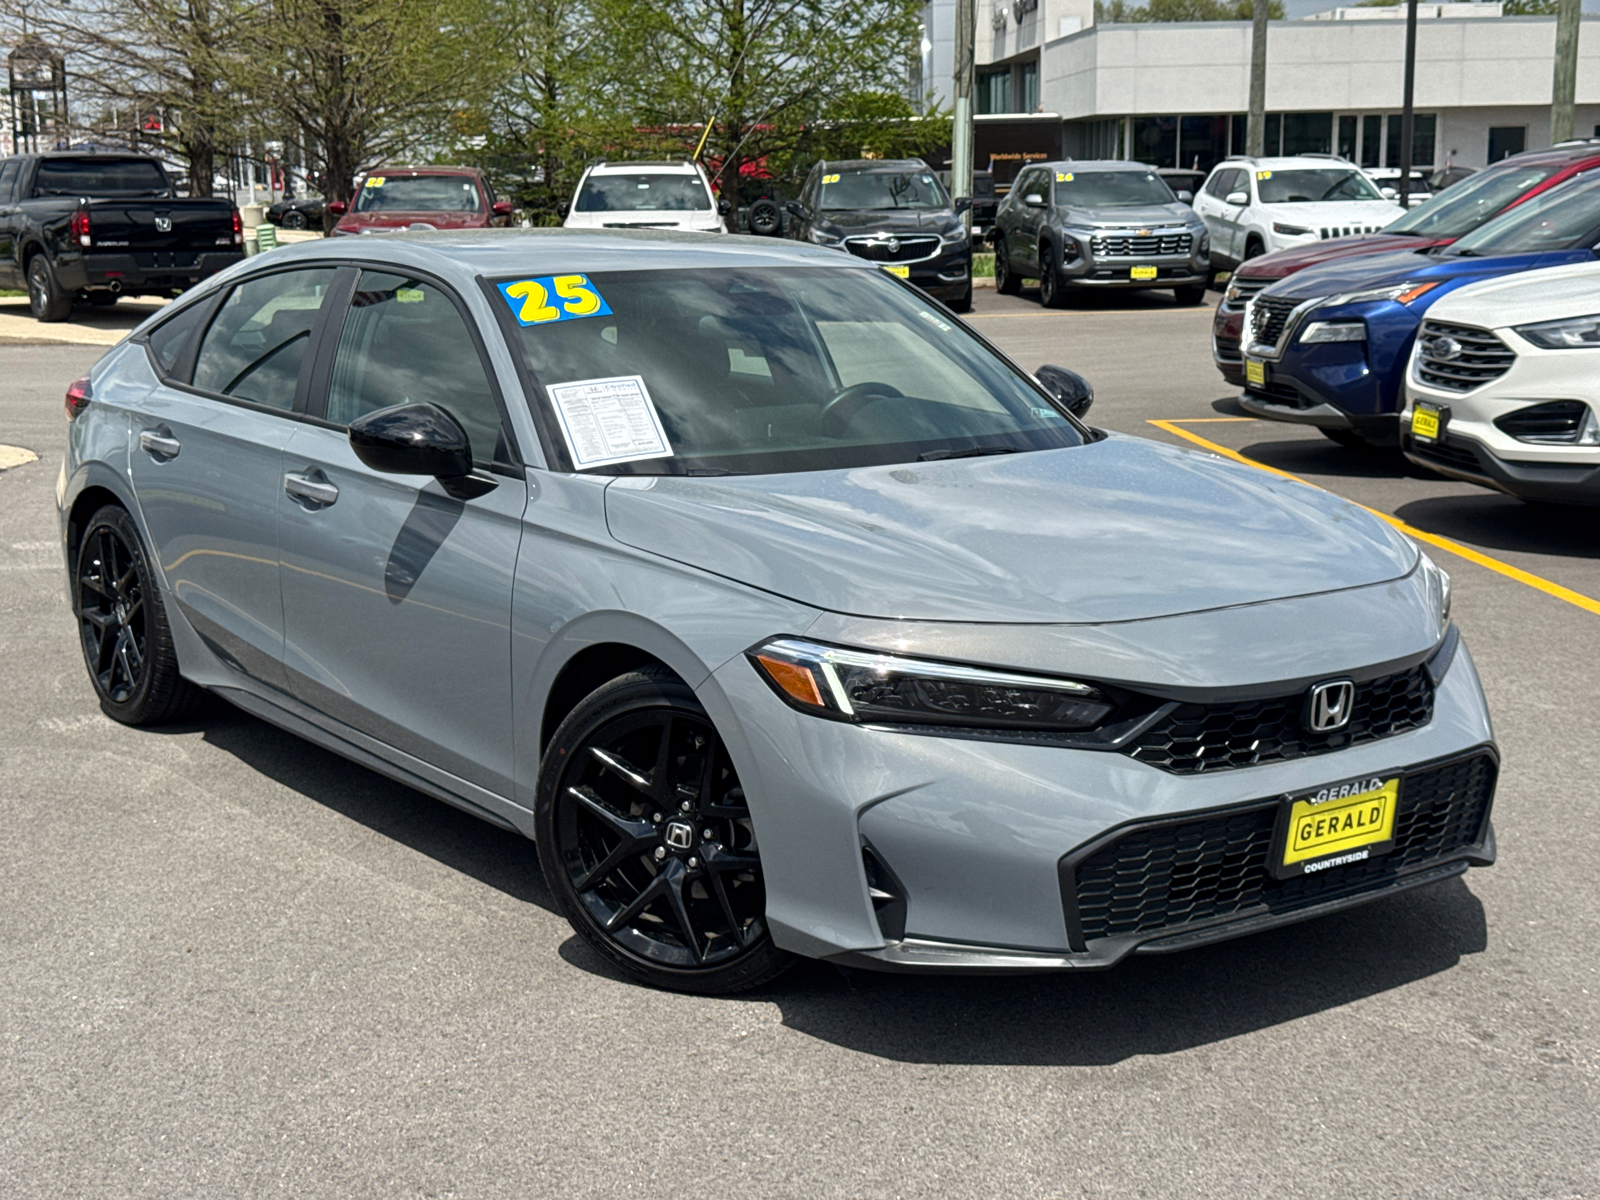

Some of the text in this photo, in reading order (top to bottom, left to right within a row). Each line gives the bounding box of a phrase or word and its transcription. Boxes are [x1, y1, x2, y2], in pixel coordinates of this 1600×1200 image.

[1022, 152, 1048, 160] Services
[505, 274, 601, 322] 25
[1316, 778, 1381, 804] GERALD
[1301, 807, 1381, 841] GERALD
[1304, 850, 1370, 874] COUNTRYSIDE
